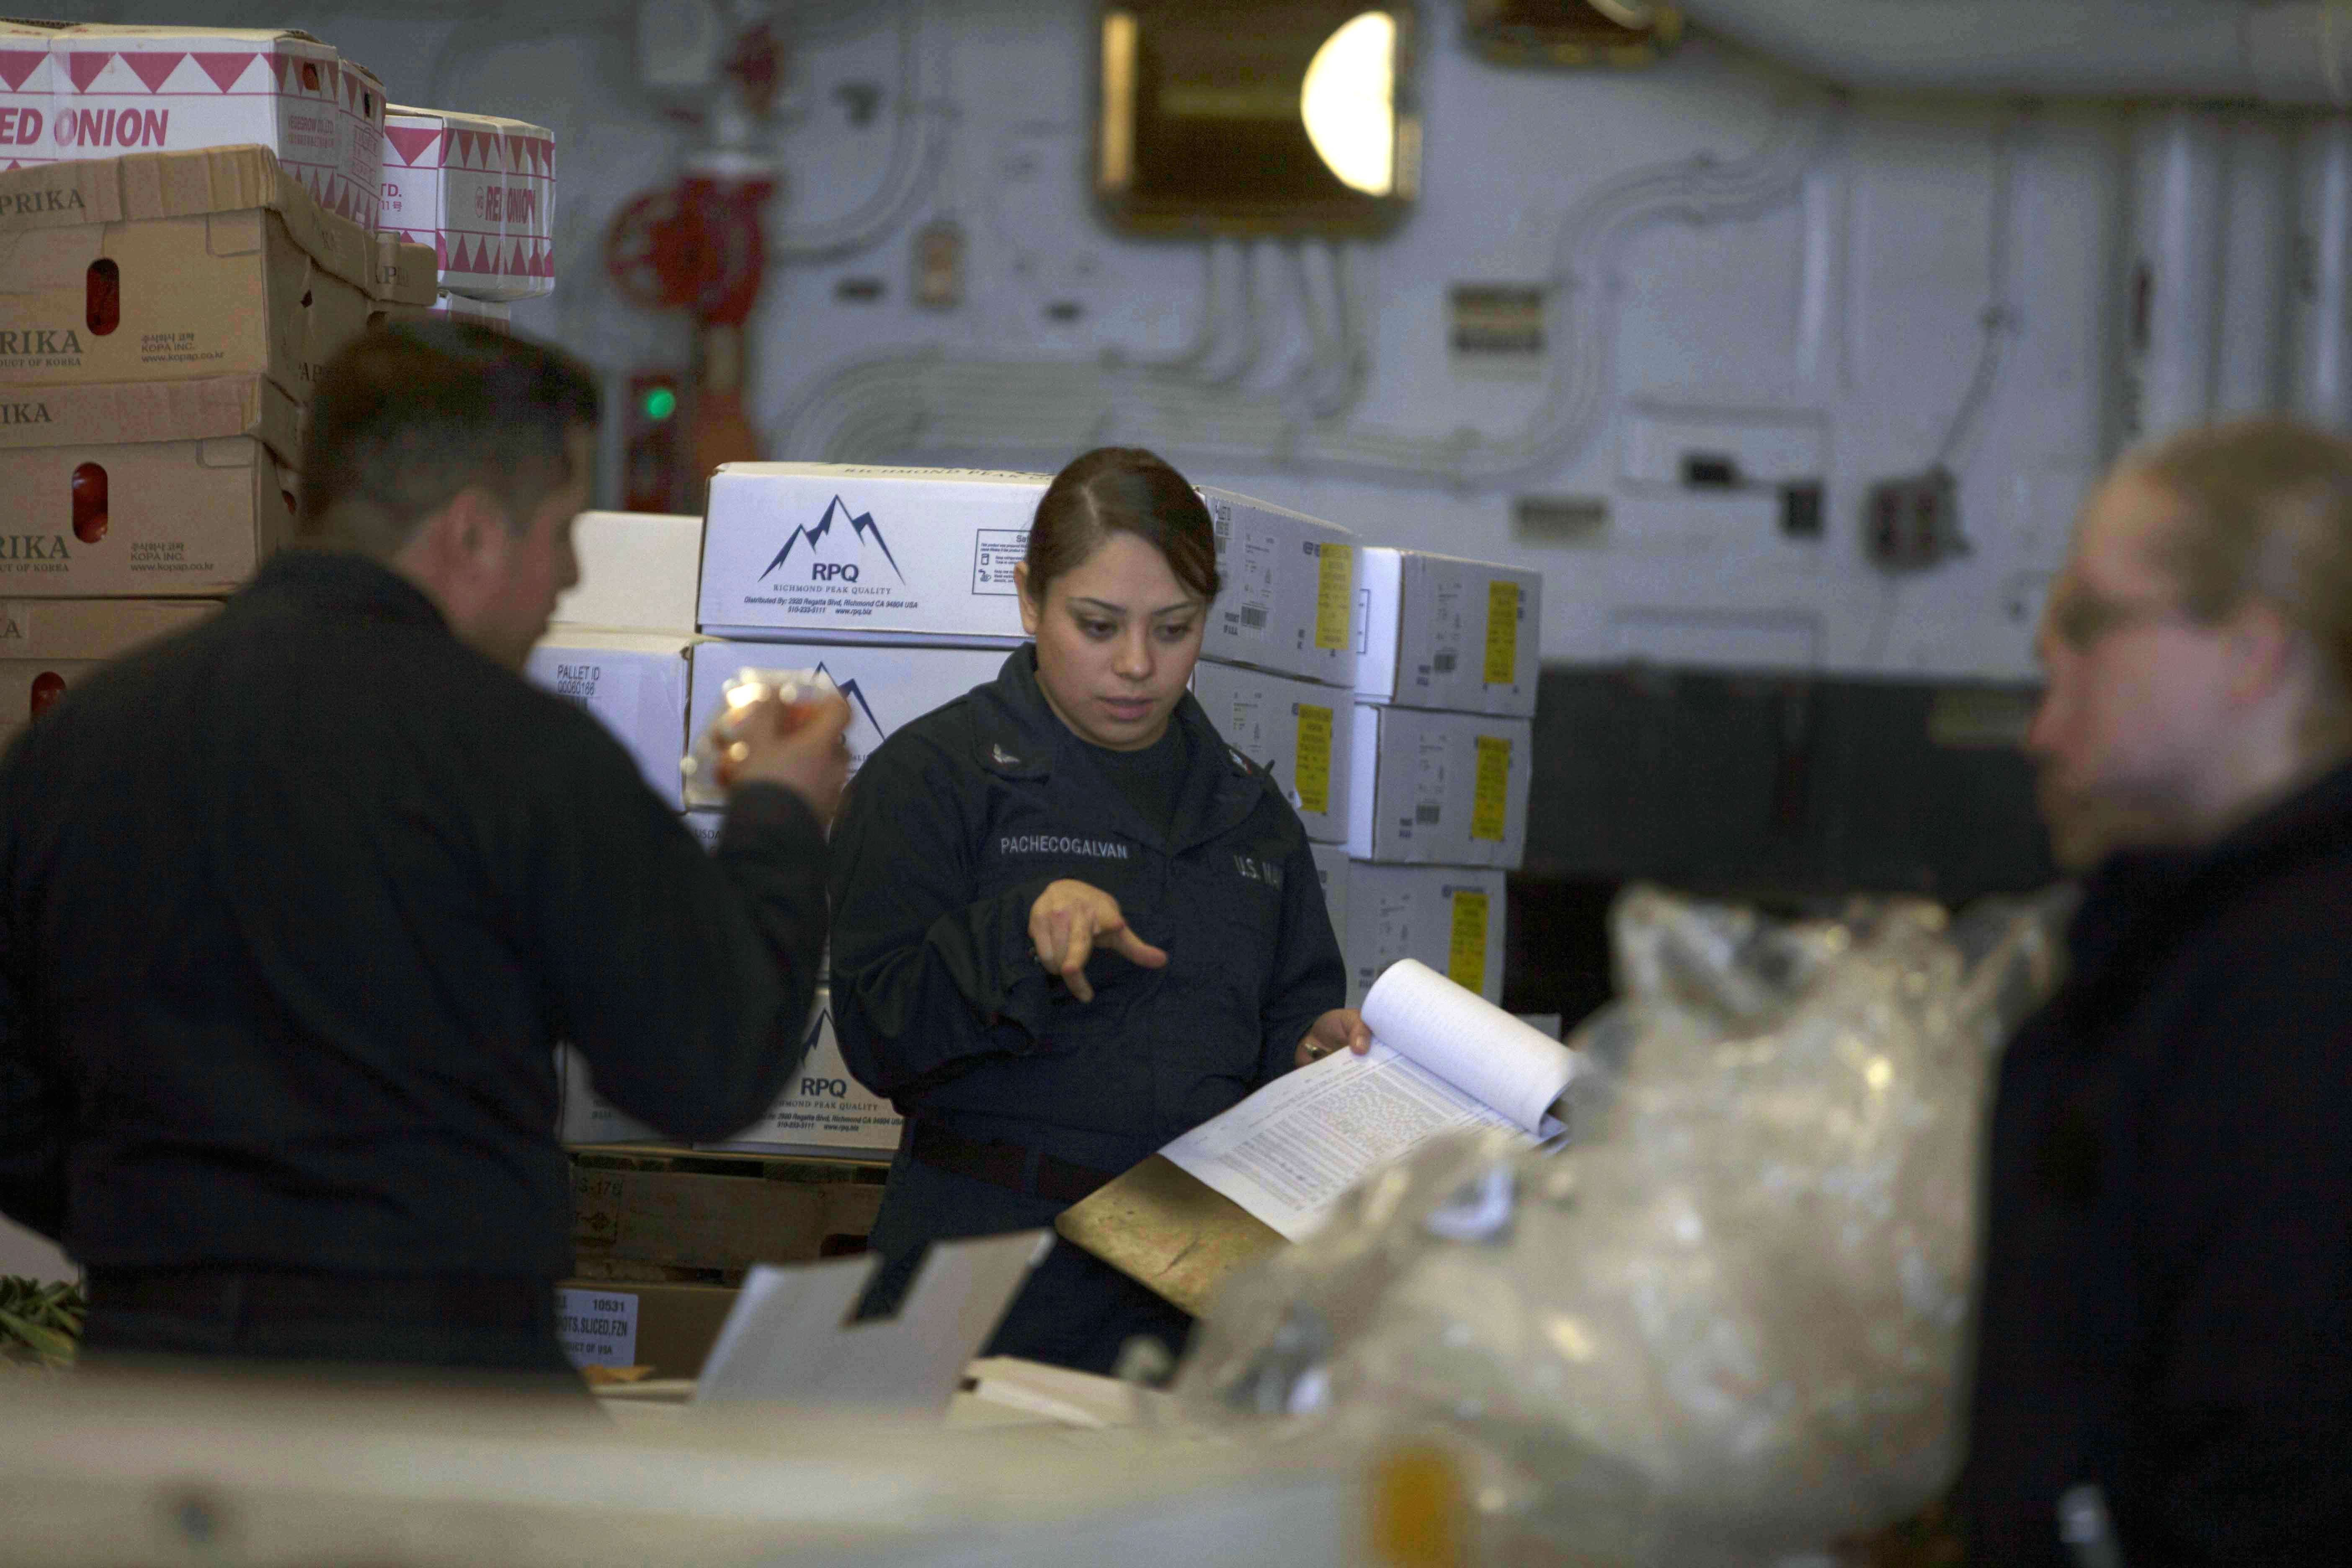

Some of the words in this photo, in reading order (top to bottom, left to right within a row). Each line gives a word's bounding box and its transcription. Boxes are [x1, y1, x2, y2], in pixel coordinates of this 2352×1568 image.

[54, 108, 169, 147] ONION
[0, 188, 85, 214] PRIKA
[507, 188, 536, 224] ONION
[0, 330, 82, 354] RIKA
[141, 343, 171, 353] KOPA
[174, 342, 195, 351] INC.
[29, 358, 42, 367] OF
[46, 358, 81, 367] KOREA
[141, 350, 224, 363] www.kopap.co.kr
[0, 402, 52, 425] IKA
[131, 552, 160, 561] KOPA
[163, 552, 184, 561] INC.
[16, 563, 30, 573] OF
[34, 563, 70, 572] KOREA
[812, 563, 859, 583] RPQ
[836, 607, 872, 616] www.rpq.biz
[0, 618, 22, 639] A
[557, 665, 590, 680] PALLET
[591, 667, 600, 681] ID
[1001, 836, 1127, 859] PACHECOGALVAN
[800, 1077, 847, 1099] RPQ
[814, 1101, 836, 1109] PEAK
[839, 1102, 878, 1111] QUALITY
[593, 1299, 625, 1313] 10531
[586, 1343, 596, 1354] OF
